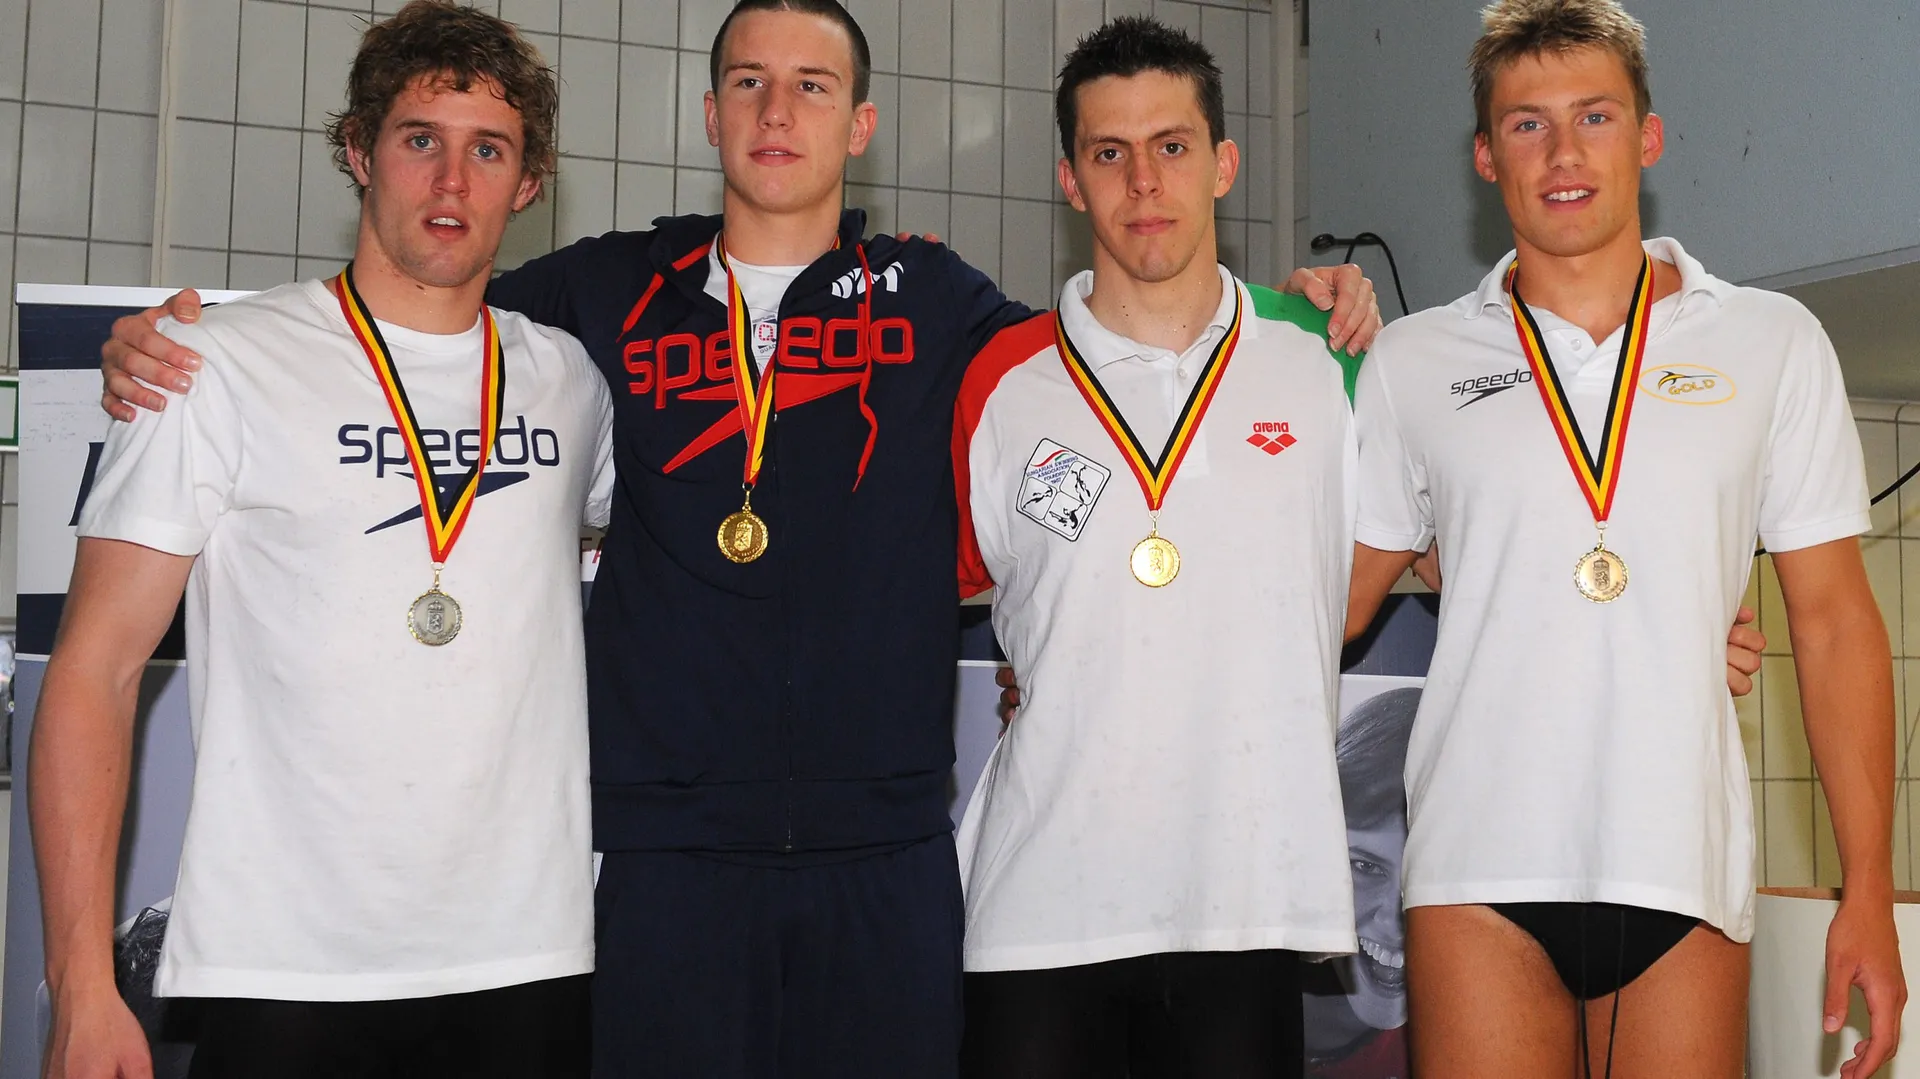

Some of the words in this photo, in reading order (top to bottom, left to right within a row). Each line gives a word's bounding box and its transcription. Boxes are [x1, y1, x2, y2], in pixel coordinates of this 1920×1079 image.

[622, 302, 914, 409] speedo
[1451, 368, 1532, 396] speedo
[1668, 379, 1716, 395] GOLD
[1253, 422, 1290, 433] arena
[338, 415, 560, 478] speedo
[1037, 464, 1070, 478] ASSOCIATION
